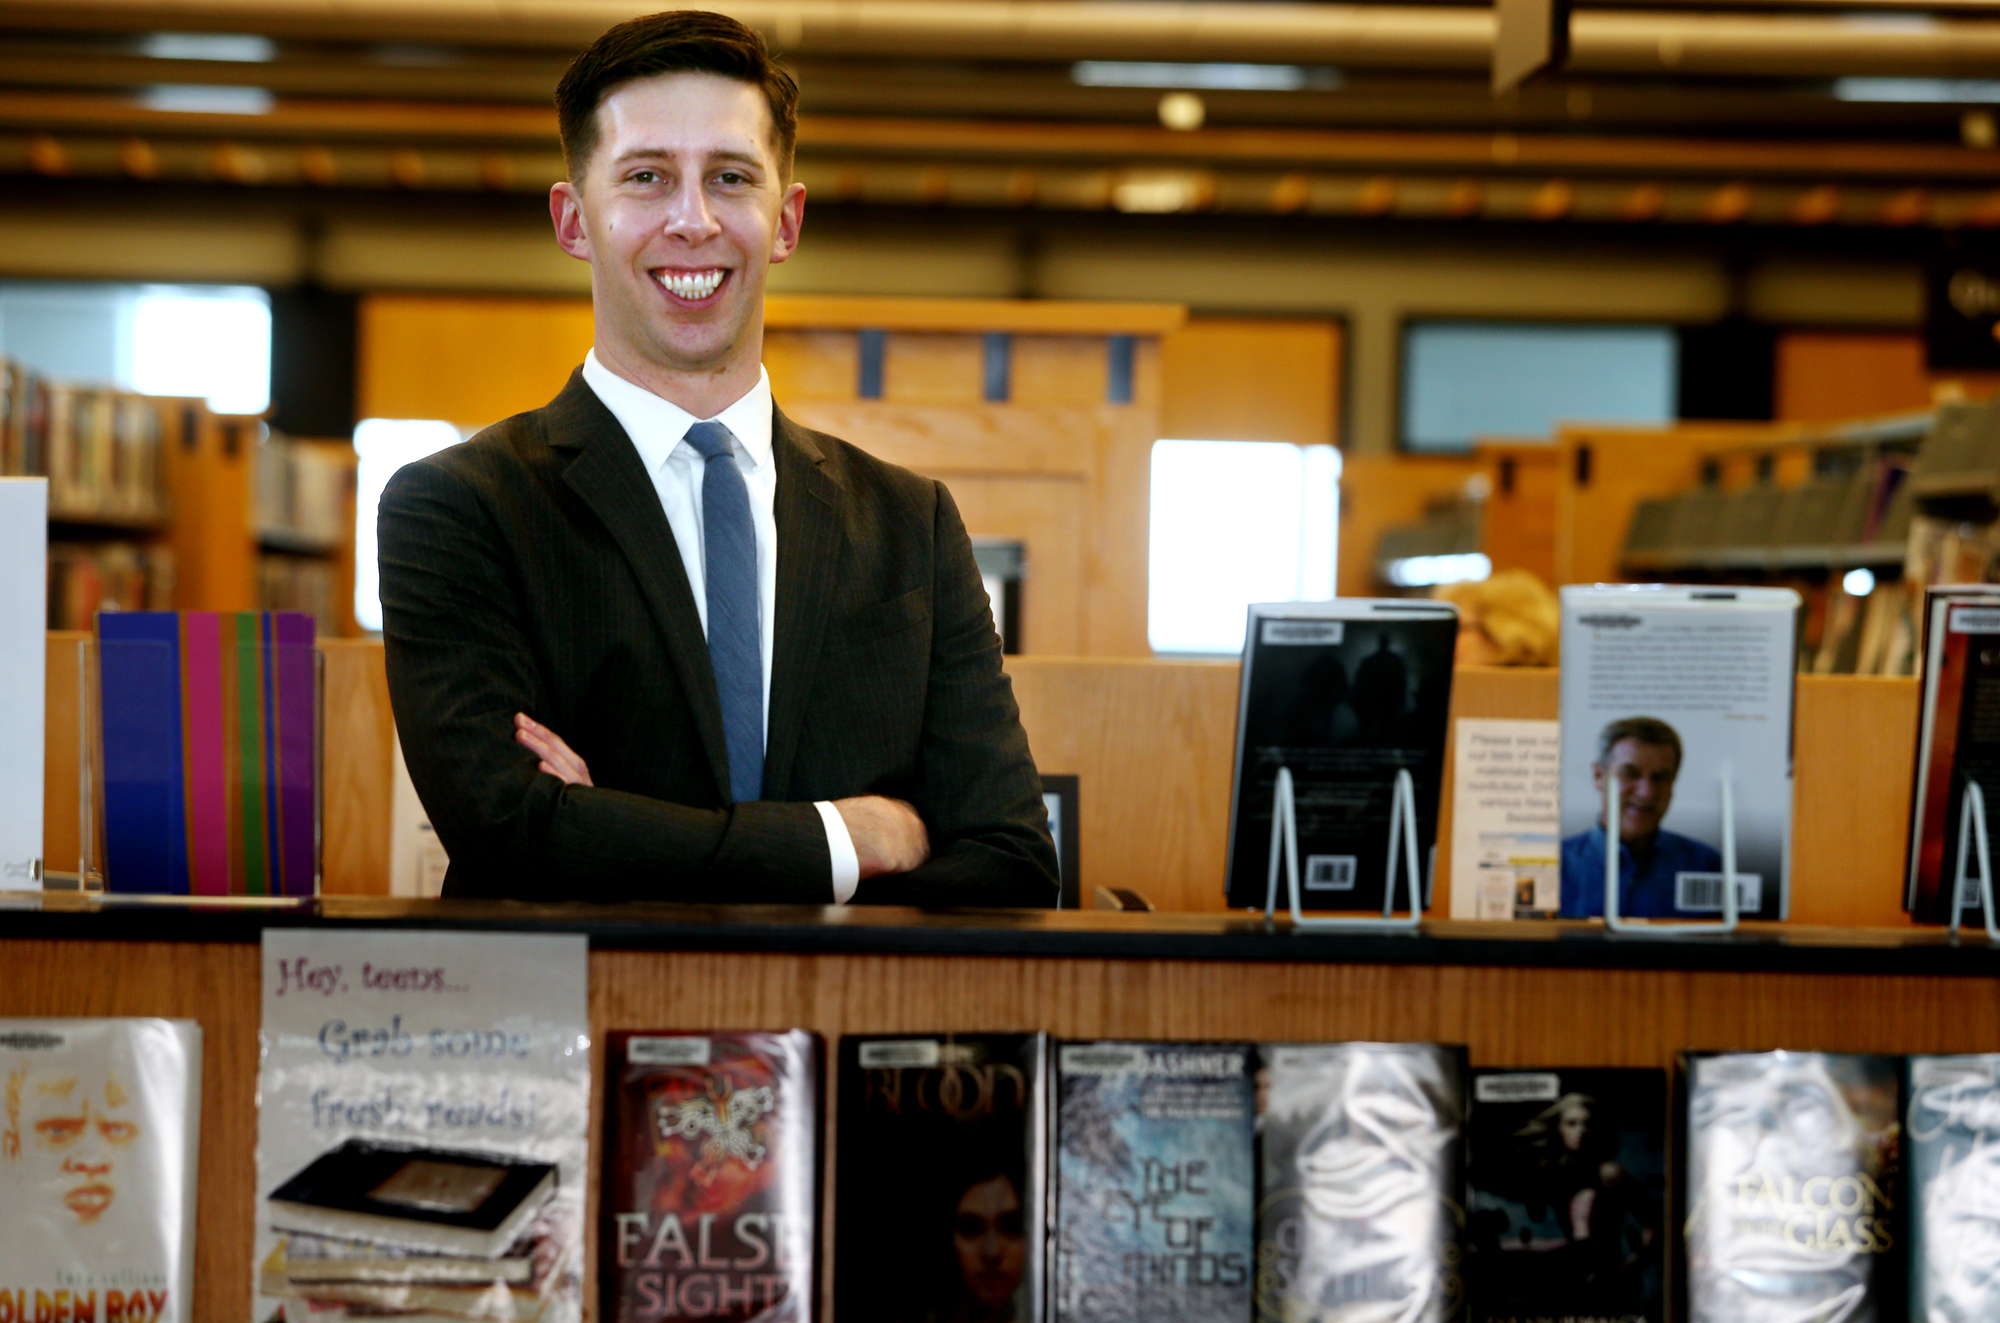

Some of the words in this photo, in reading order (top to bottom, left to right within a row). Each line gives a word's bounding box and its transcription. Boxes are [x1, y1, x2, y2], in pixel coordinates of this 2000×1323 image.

[275, 956, 349, 997] Hey,
[317, 1014, 414, 1065] Grab
[428, 1027, 532, 1060] some
[310, 1086, 408, 1130] fresh
[1736, 1169, 1895, 1220] FALCON
[1783, 1212, 1896, 1254] GLASS
[106, 1288, 169, 1323] BOY
[635, 1272, 792, 1318] SIGHT
